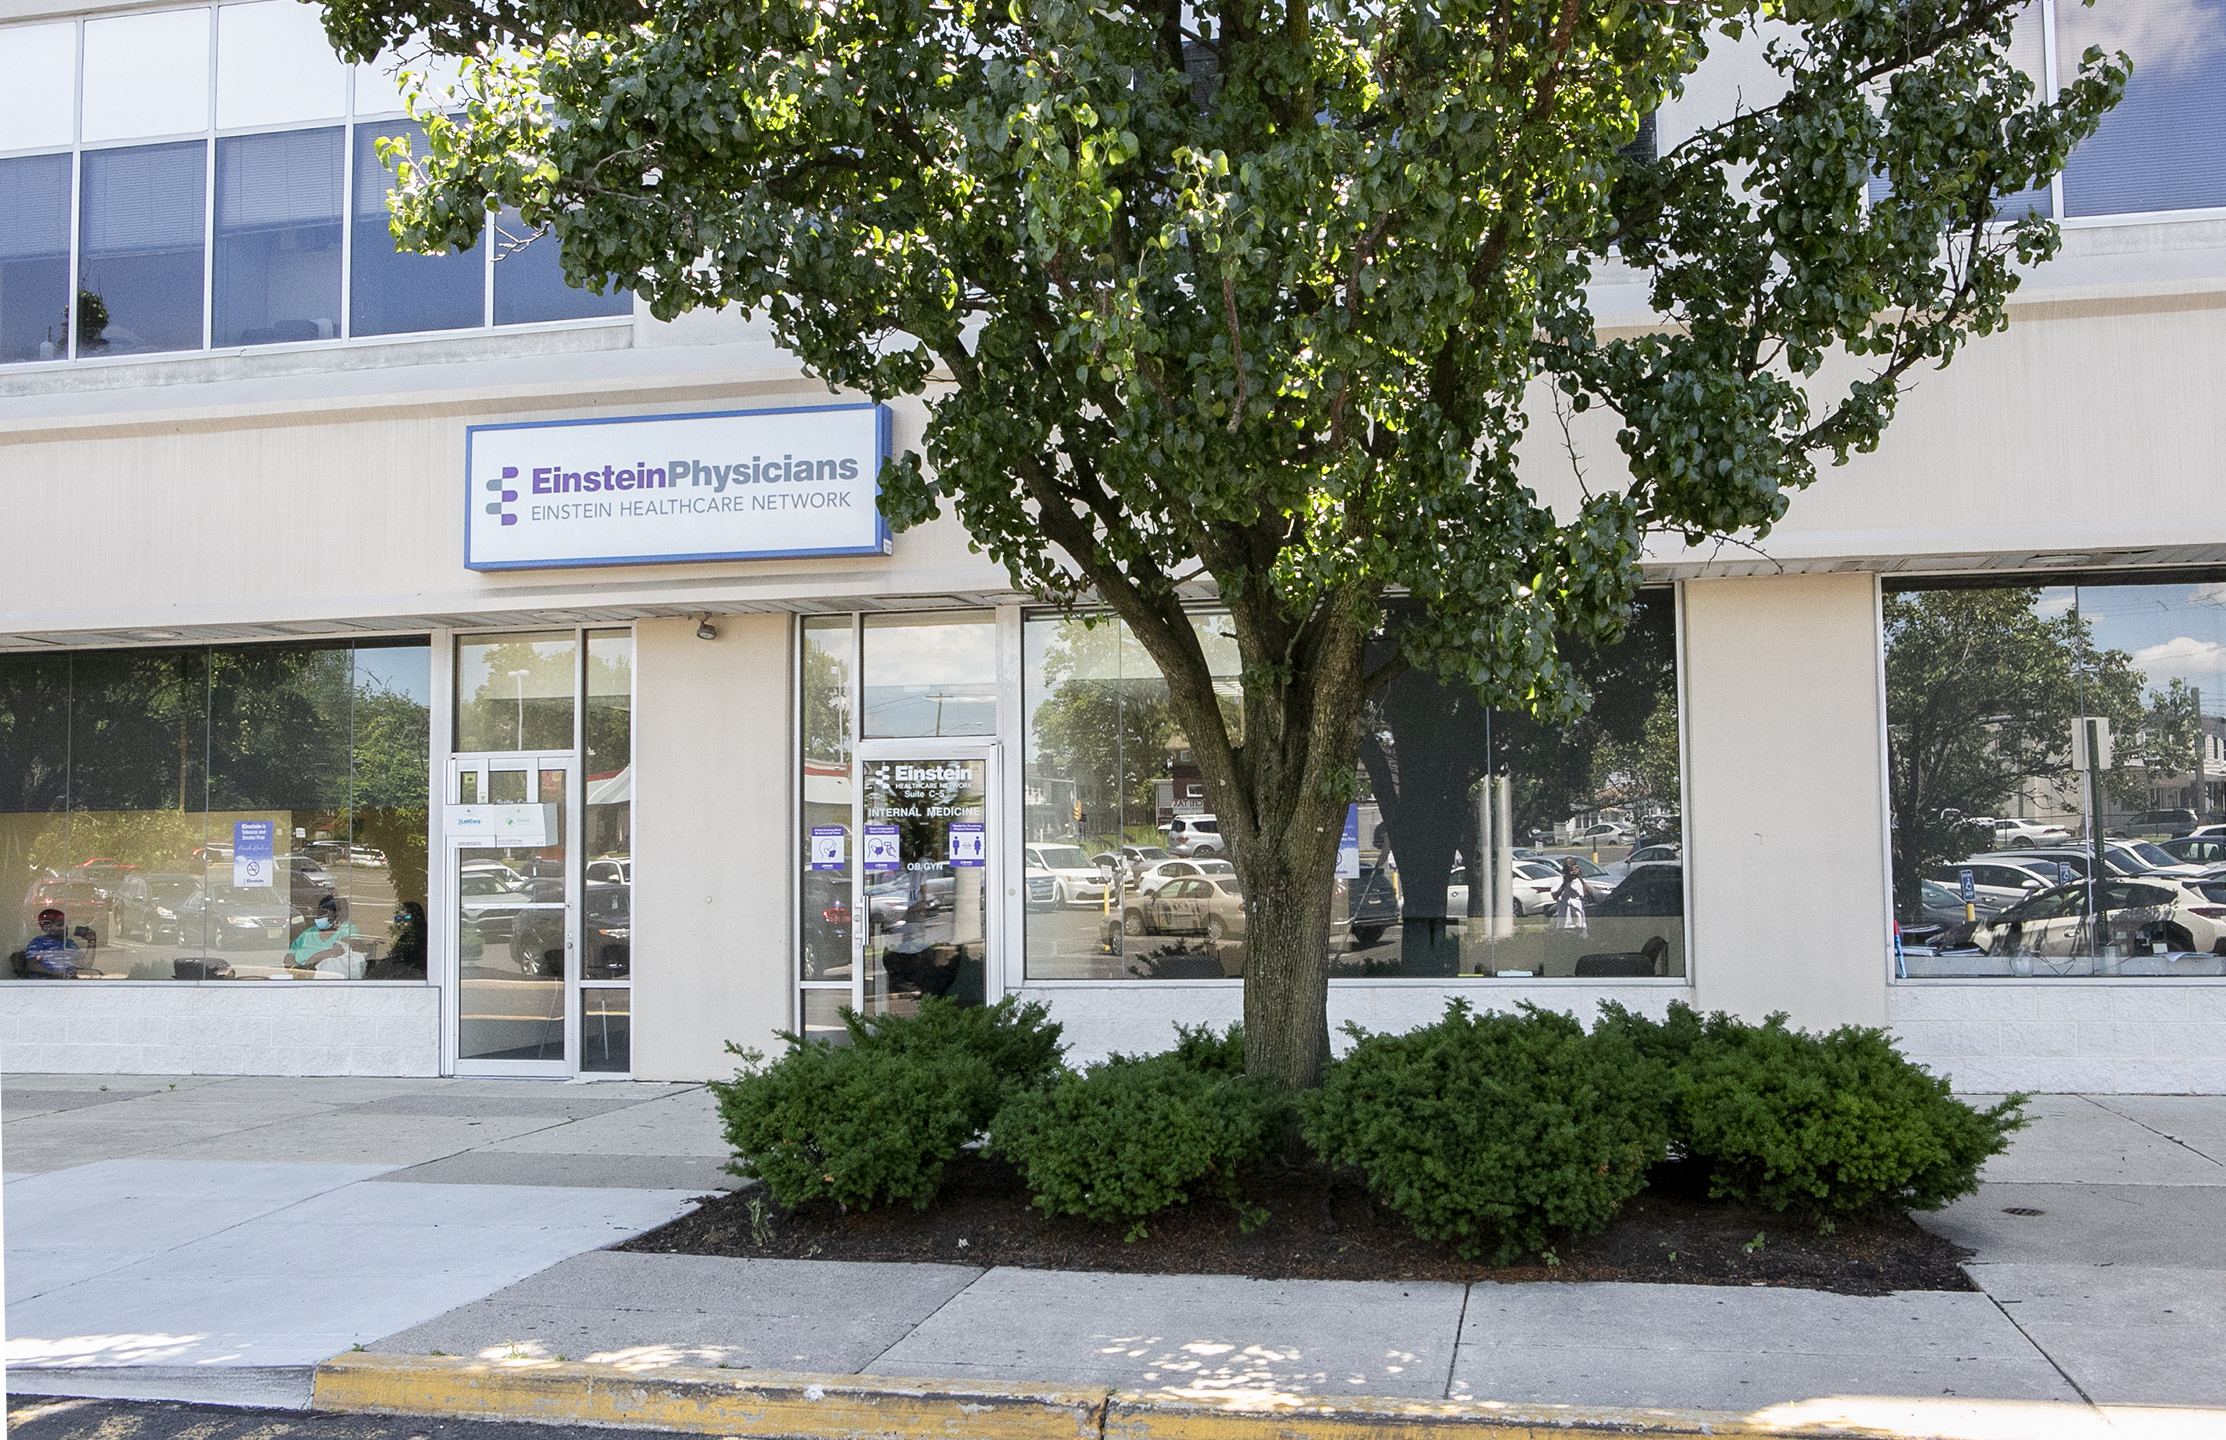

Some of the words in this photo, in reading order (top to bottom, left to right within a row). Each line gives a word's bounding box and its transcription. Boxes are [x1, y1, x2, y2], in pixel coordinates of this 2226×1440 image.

[532, 454, 859, 494] EinsteinPhysicians
[531, 502, 612, 521] EINSTEIN
[620, 496, 744, 517] HEALTHCARE
[751, 491, 852, 512] NETWORK
[895, 765, 973, 781] Einstein
[868, 808, 922, 817] INTERNAL
[927, 806, 980, 816] MEDICINE
[907, 863, 943, 871] OB/GYN
